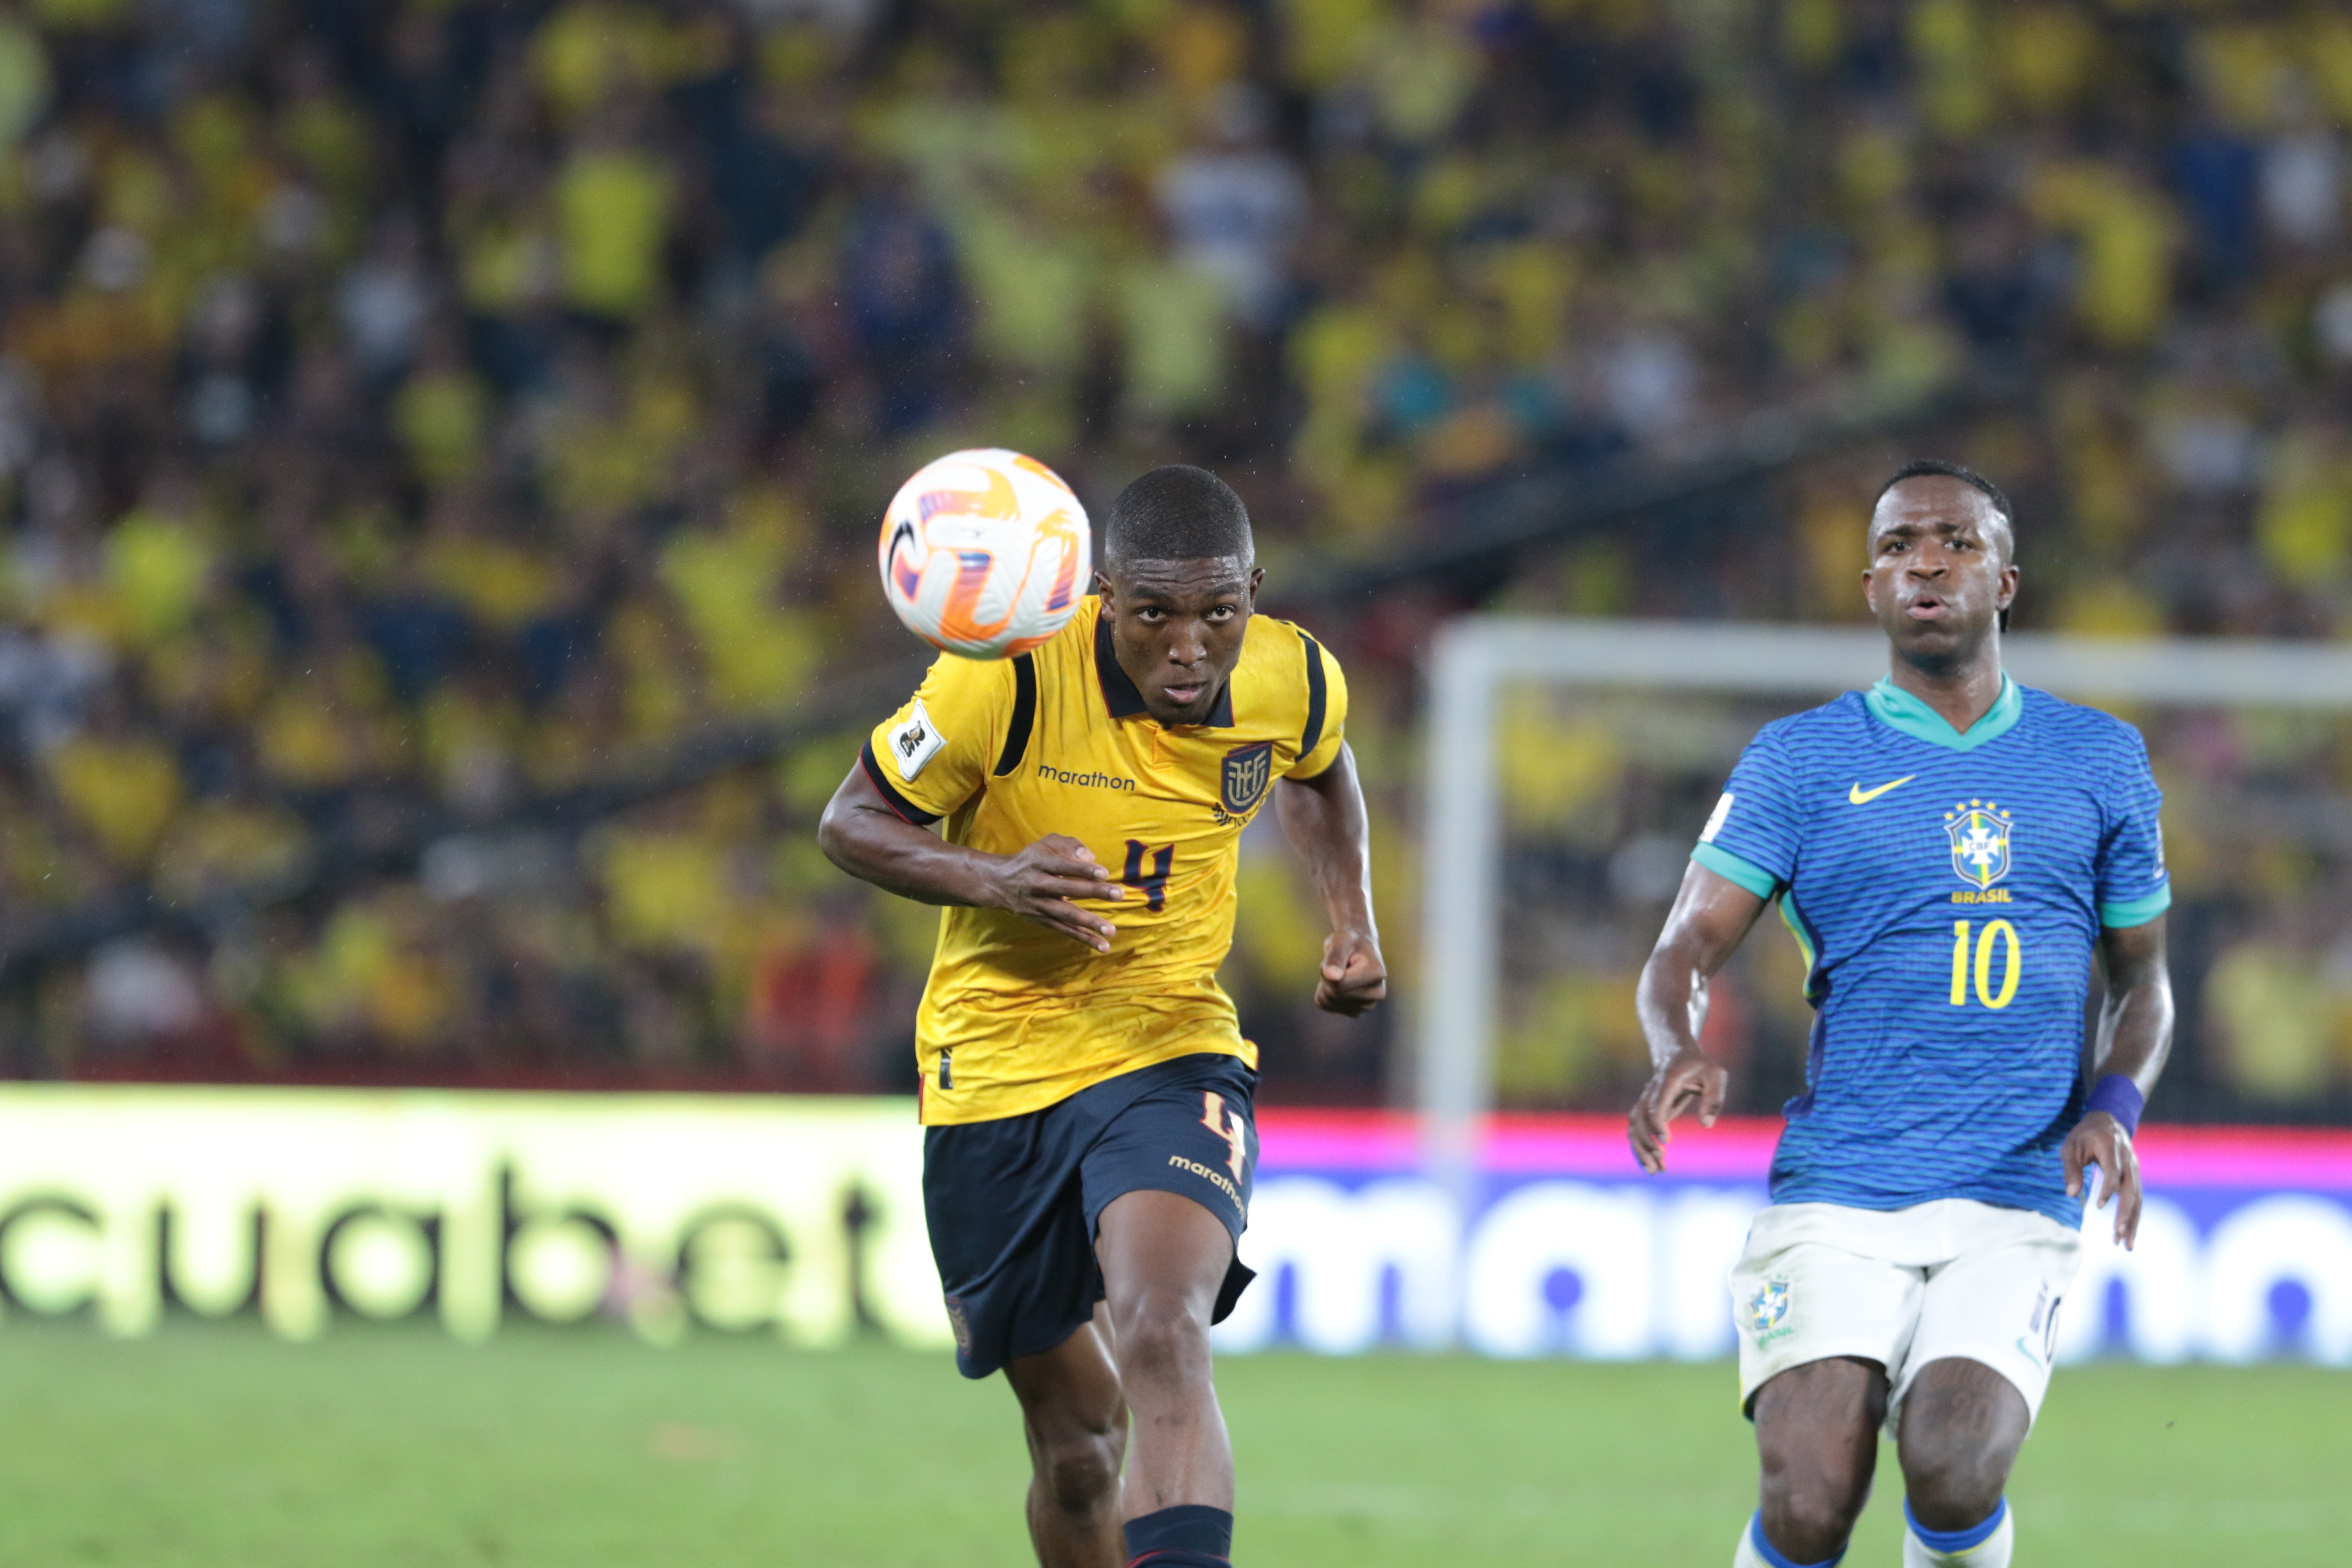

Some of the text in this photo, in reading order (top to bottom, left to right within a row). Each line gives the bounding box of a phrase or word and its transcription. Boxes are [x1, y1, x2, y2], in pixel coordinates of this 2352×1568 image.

[1038, 765, 1135, 791] marathon
[1969, 841, 1990, 851] CBF
[1124, 839, 1174, 912] 4
[1951, 889, 2013, 904] BRASIL
[1950, 919, 2020, 1009] 10
[1199, 1090, 1246, 1186] 4
